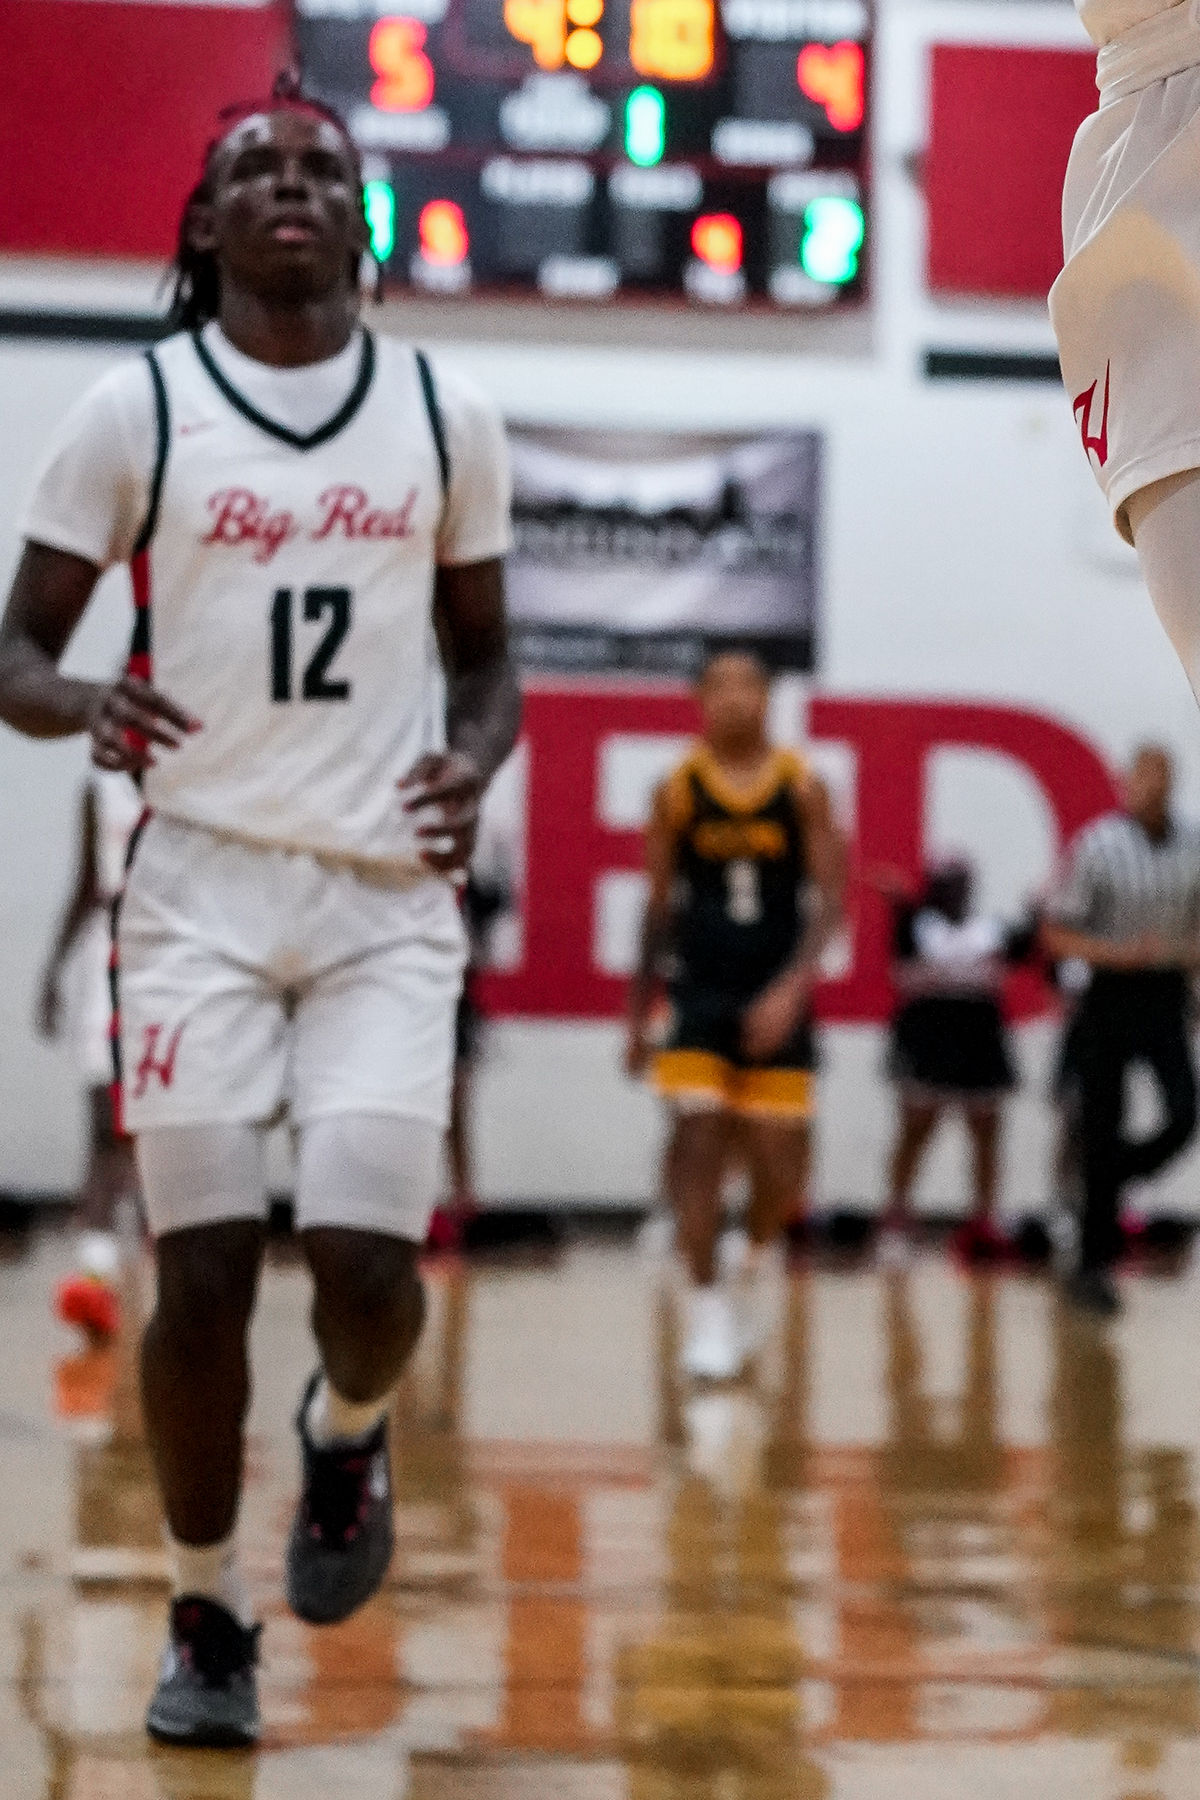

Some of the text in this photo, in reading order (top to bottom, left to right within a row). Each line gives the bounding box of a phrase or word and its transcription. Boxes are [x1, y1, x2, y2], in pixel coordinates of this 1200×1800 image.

[199, 480, 420, 567] Big Red
[269, 584, 353, 703] 12
